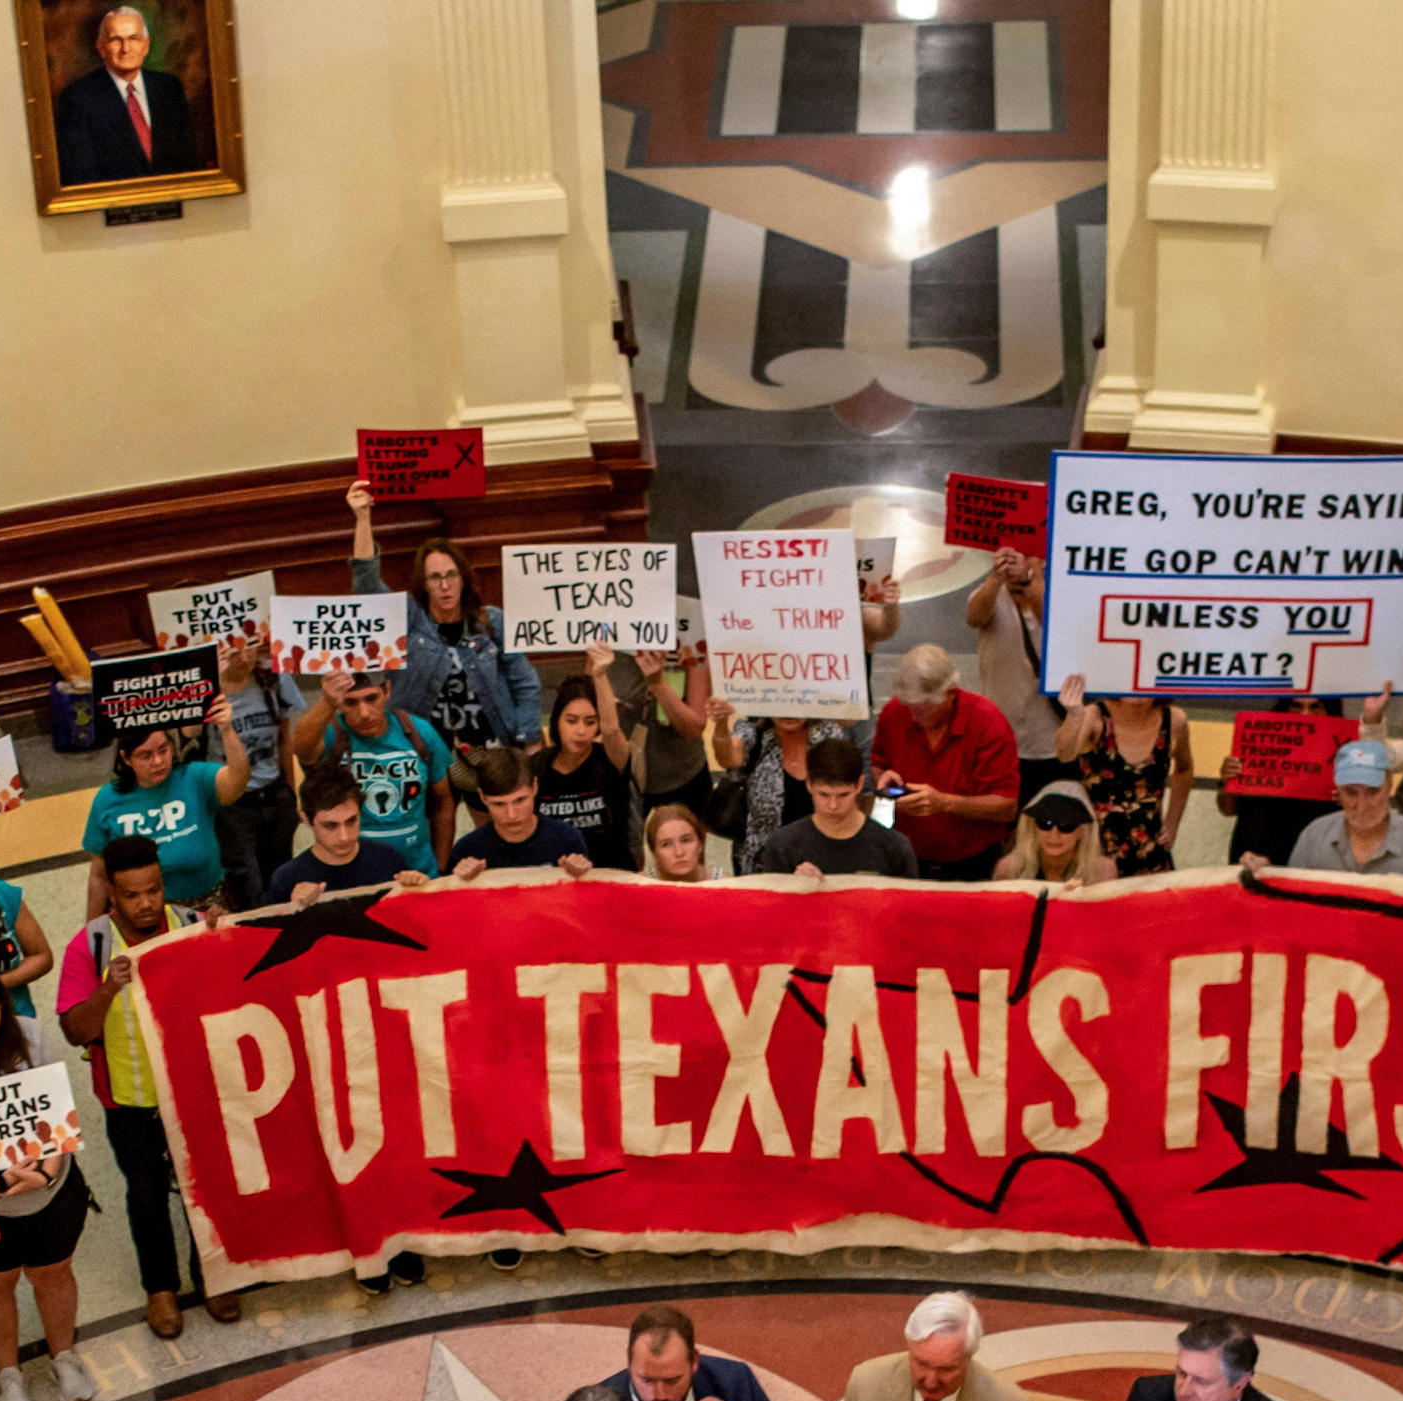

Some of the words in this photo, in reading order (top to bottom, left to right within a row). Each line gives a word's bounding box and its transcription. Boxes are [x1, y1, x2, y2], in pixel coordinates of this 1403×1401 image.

[366, 449, 428, 459] LETTING
[367, 460, 418, 470] TRUMP
[367, 471, 408, 481] TAKE
[410, 469, 450, 480] OVER
[369, 485, 416, 496] TEXAS
[956, 494, 1017, 510] LETTING
[956, 504, 1007, 518] TRUMP
[1067, 488, 1169, 522] GREG,
[1191, 488, 1304, 520] YOU'RE
[956, 514, 993, 529] TAKE
[997, 521, 1035, 534] OVER
[953, 529, 999, 545] TEXAS
[723, 540, 827, 561] RESIST!
[1066, 545, 1127, 573] THE
[1145, 547, 1220, 574] GOP
[1235, 546, 1327, 576] CAN'T
[513, 552, 563, 576] THE
[577, 549, 630, 572] EYES
[644, 550, 668, 571] OF
[740, 568, 822, 589] FIGHT!
[191, 589, 232, 608] PUT
[544, 579, 633, 612] TEXAS
[173, 598, 256, 625] TEXANS
[317, 604, 361, 619] PUT
[718, 610, 754, 632] the
[772, 608, 844, 632] TRUMP
[1121, 602, 1260, 629] UNLESS
[1285, 603, 1352, 630] YOU
[189, 615, 245, 637] FIRST
[293, 619, 384, 635] TEXANS
[514, 620, 561, 648] ARE
[567, 621, 617, 645] UPON
[631, 622, 669, 645] YOU
[308, 635, 370, 651] FIRST
[714, 653, 850, 683] TAKEOVER!
[113, 673, 164, 693] FIGHT
[167, 667, 201, 686] THE
[101, 680, 213, 718] TRUMP
[113, 706, 203, 729] TAKEOVER
[1241, 733, 1302, 746] LETTING
[1241, 745, 1291, 757] TRUMP
[1242, 758, 1278, 770] TAKE
[1282, 761, 1320, 773] OVER
[1237, 775, 1284, 787] TEXAS
[200, 968, 467, 1195] PUT
[515, 962, 1110, 1161] TEXANS
